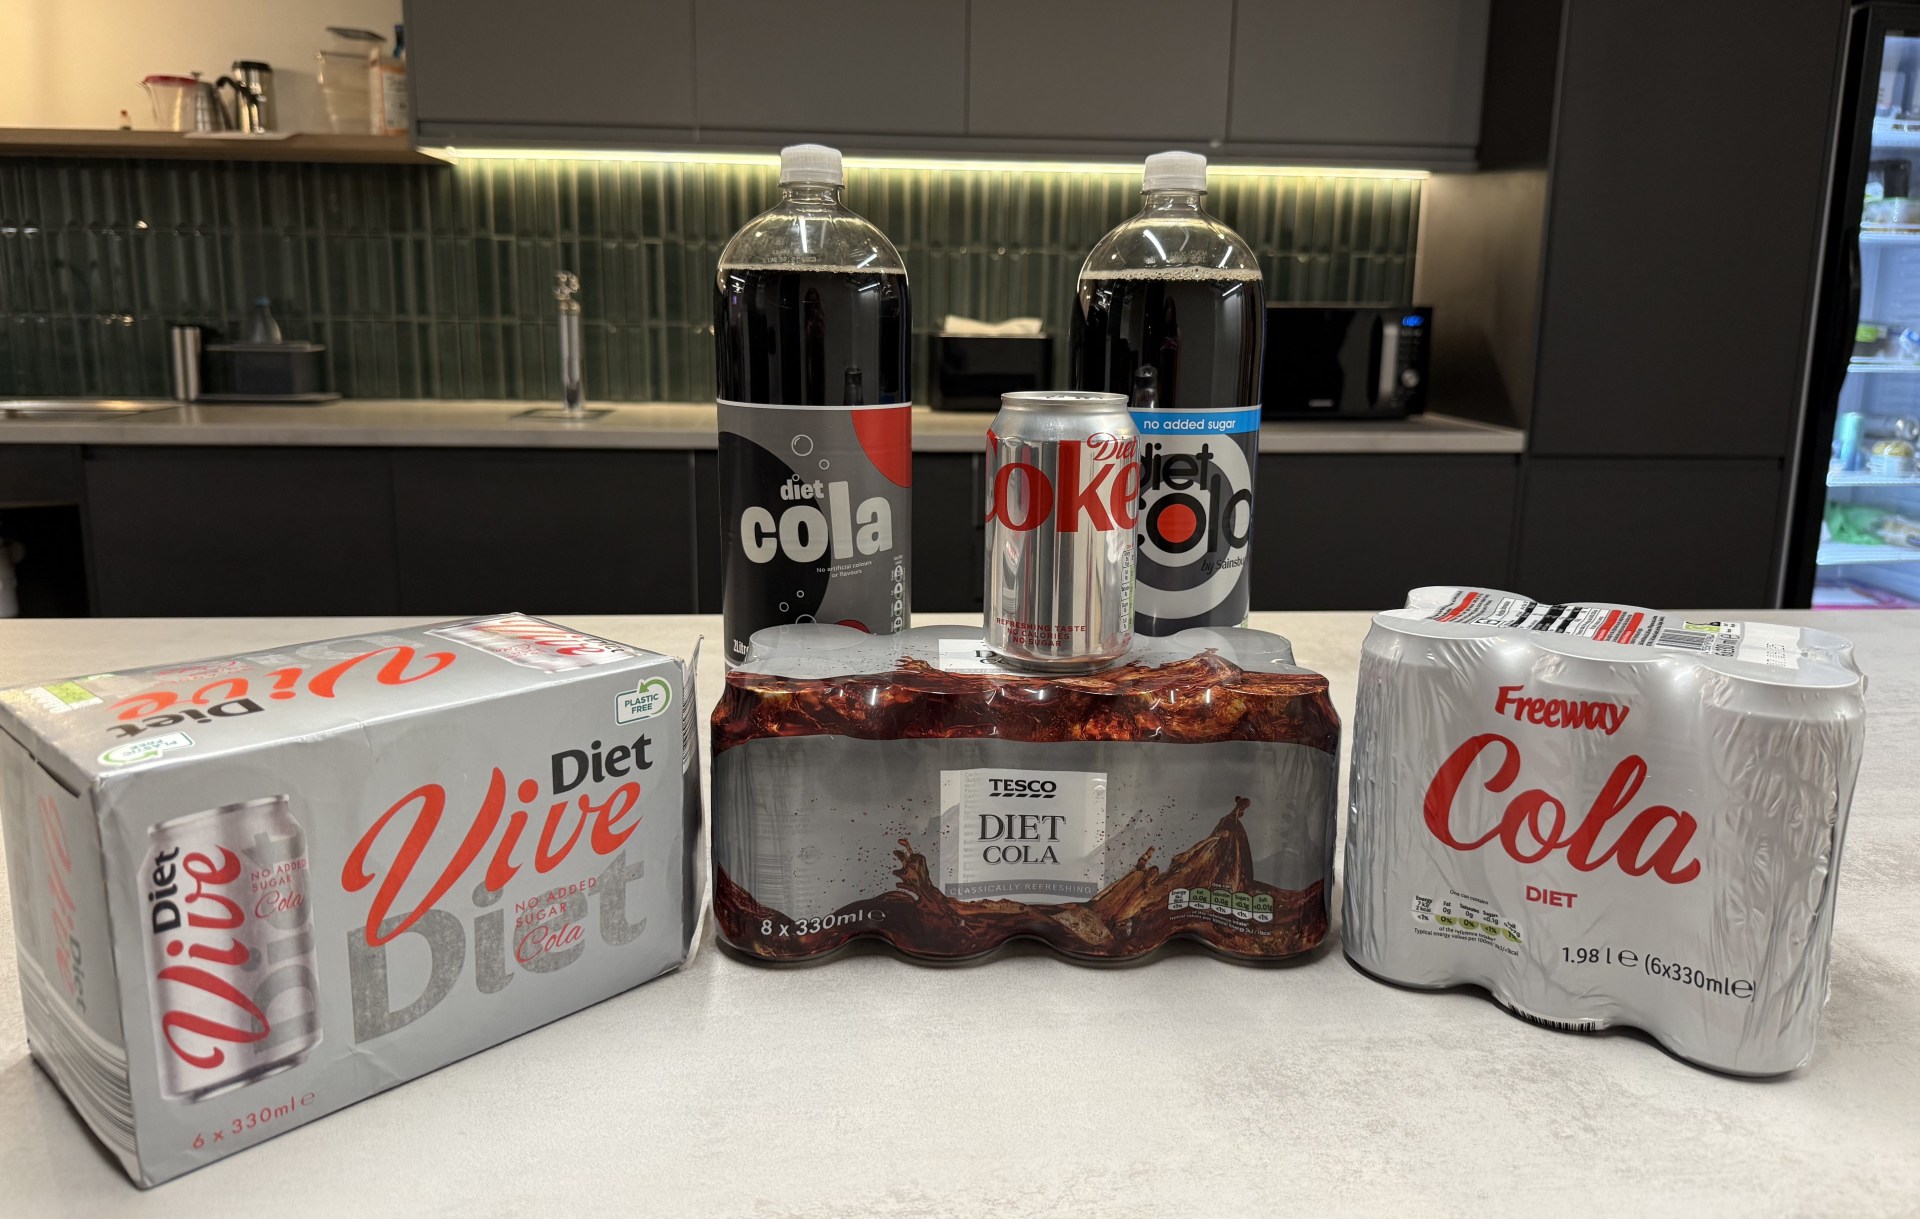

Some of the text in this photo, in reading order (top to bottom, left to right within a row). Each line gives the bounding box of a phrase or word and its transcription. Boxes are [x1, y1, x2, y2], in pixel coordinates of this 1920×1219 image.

[1143, 418, 1236, 431] no added sugar
[1086, 431, 1137, 462] Diet
[780, 474, 825, 501] diet
[986, 429, 1140, 533] oke
[740, 480, 893, 564] cola
[1138, 473, 1252, 553] ola
[827, 563, 852, 573] artificial
[852, 560, 873, 569] colours
[839, 569, 863, 577] flavours
[1201, 559, 1215, 575] by
[996, 617, 1087, 633] REFRESHING TASTE
[1008, 627, 1070, 640] NO CALORIES
[1013, 636, 1062, 647] NO SUGAR
[102, 646, 457, 721] Vive
[624, 693, 660, 708] PLASTIC
[631, 702, 654, 715] FREE
[1494, 684, 1631, 736] Freeway
[106, 698, 266, 739] Diet
[551, 732, 654, 796] Diet
[988, 778, 1057, 793] TESCO
[1423, 733, 1702, 885] Cola
[978, 813, 1067, 842] DIET
[341, 766, 644, 947] Vive
[983, 845, 1061, 866] COLA
[251, 858, 307, 881] NO ADDED
[148, 846, 182, 935] Diet
[252, 873, 292, 893] SUGAR
[515, 877, 597, 914] NO ADDED
[949, 883, 1093, 896] CLASSICALLY REFRESHING
[254, 890, 305, 919] Cola
[1525, 884, 1578, 909] DIET
[515, 902, 567, 928] SUGAR
[760, 919, 773, 936] 8
[778, 924, 790, 937] x
[795, 909, 864, 936] 330ml
[1440, 915, 1453, 924] 0%
[1442, 906, 1452, 915] 0g
[1465, 910, 1474, 919] 0g
[1414, 927, 1433, 936] Typical
[1463, 919, 1475, 928] 0%
[515, 922, 586, 964] Cola
[1561, 946, 1601, 964] 1.98
[157, 844, 271, 1070] Vive
[192, 1133, 205, 1150] 6
[213, 1129, 225, 1142] x
[231, 1096, 296, 1134] 330ml
